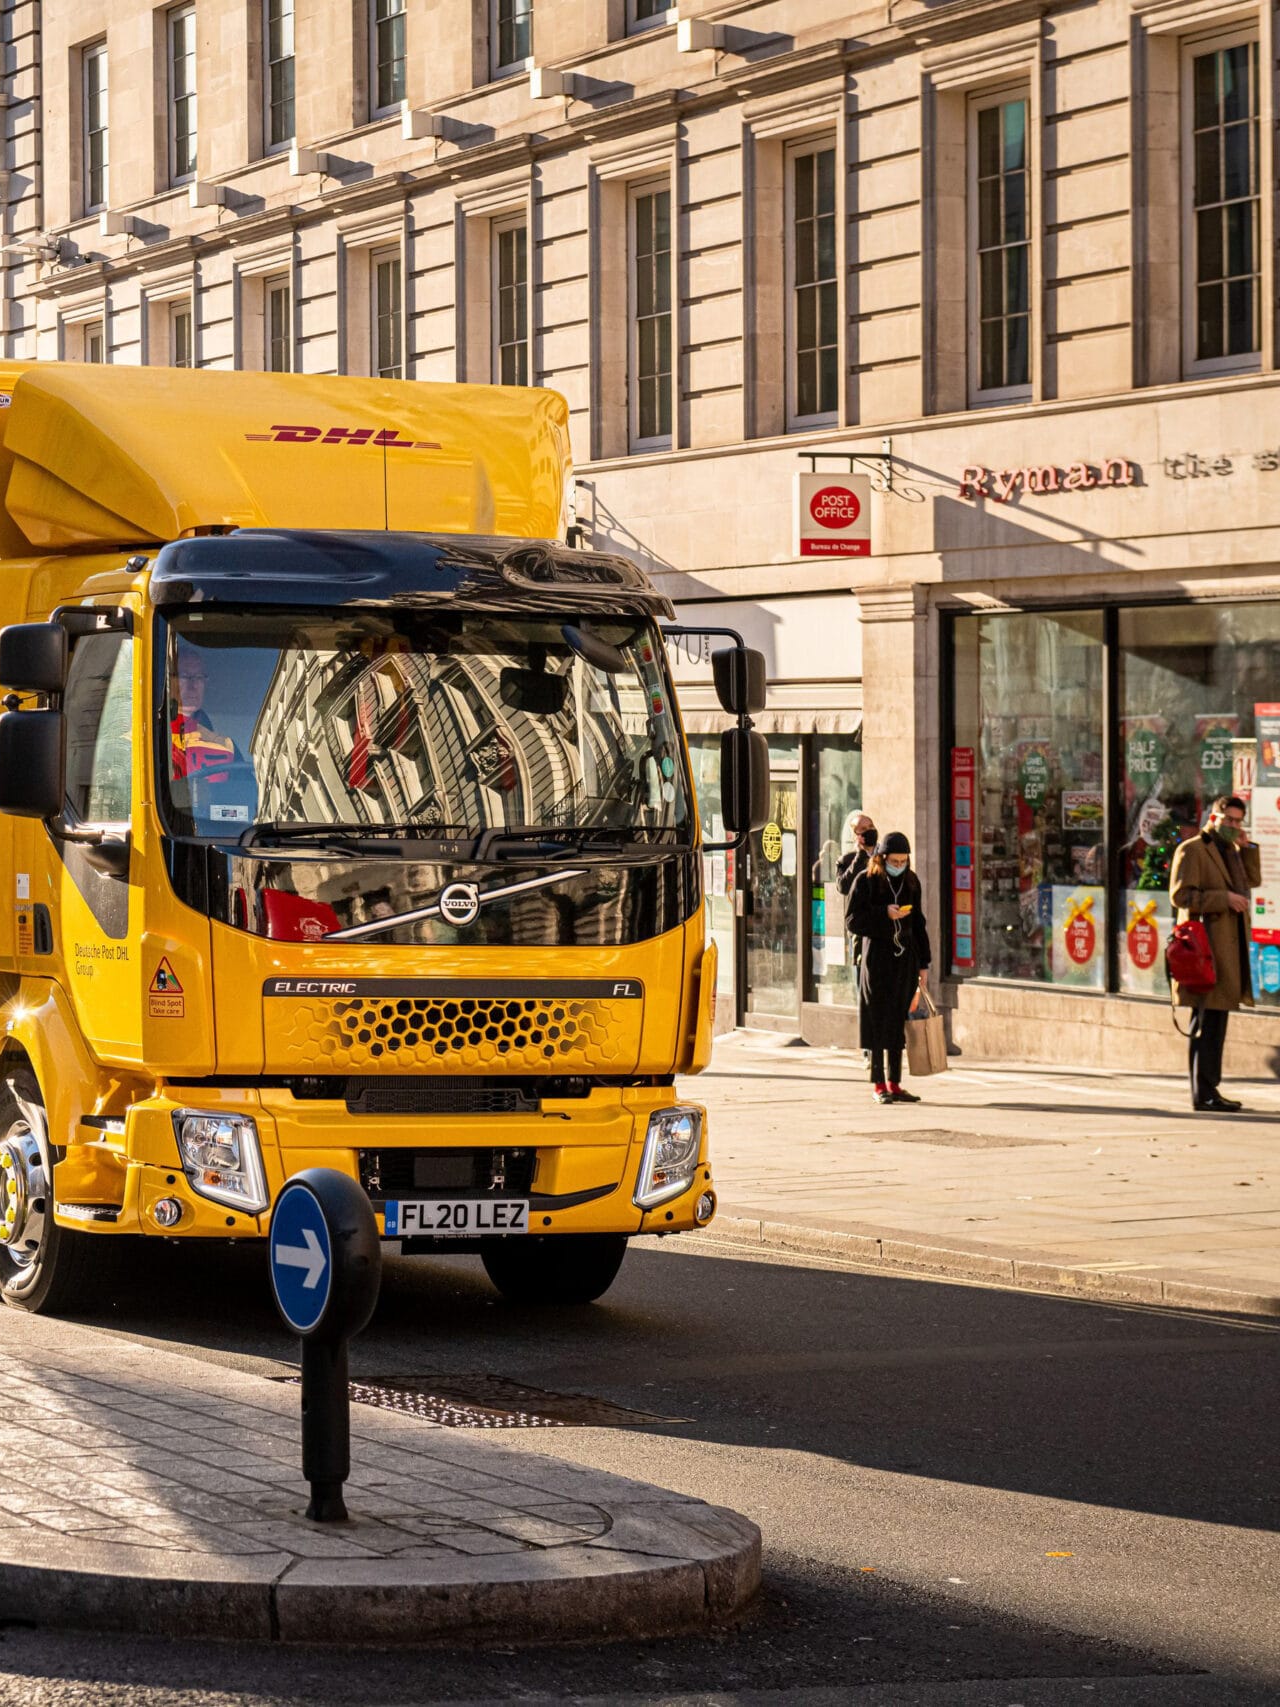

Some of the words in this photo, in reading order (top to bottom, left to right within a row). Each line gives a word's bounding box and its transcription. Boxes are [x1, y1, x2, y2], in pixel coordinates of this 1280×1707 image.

[270, 425, 414, 448] DHL
[958, 456, 1133, 503] Ryman
[1163, 451, 1234, 480] the
[821, 495, 851, 506] POST
[814, 507, 855, 518] OFFICE
[840, 543, 860, 551] Change
[1129, 741, 1156, 756] HALF
[1128, 757, 1158, 773] PRICE
[443, 900, 478, 909] VOLVO
[75, 943, 100, 959] Deutsche
[101, 946, 115, 960] Post
[116, 946, 130, 961] DHL
[75, 961, 94, 980] Group
[274, 982, 357, 994] ELECTRIC
[613, 983, 636, 996] FL
[167, 1000, 182, 1009] Spot
[401, 1203, 468, 1230] FL20
[476, 1203, 525, 1228] LEZ
